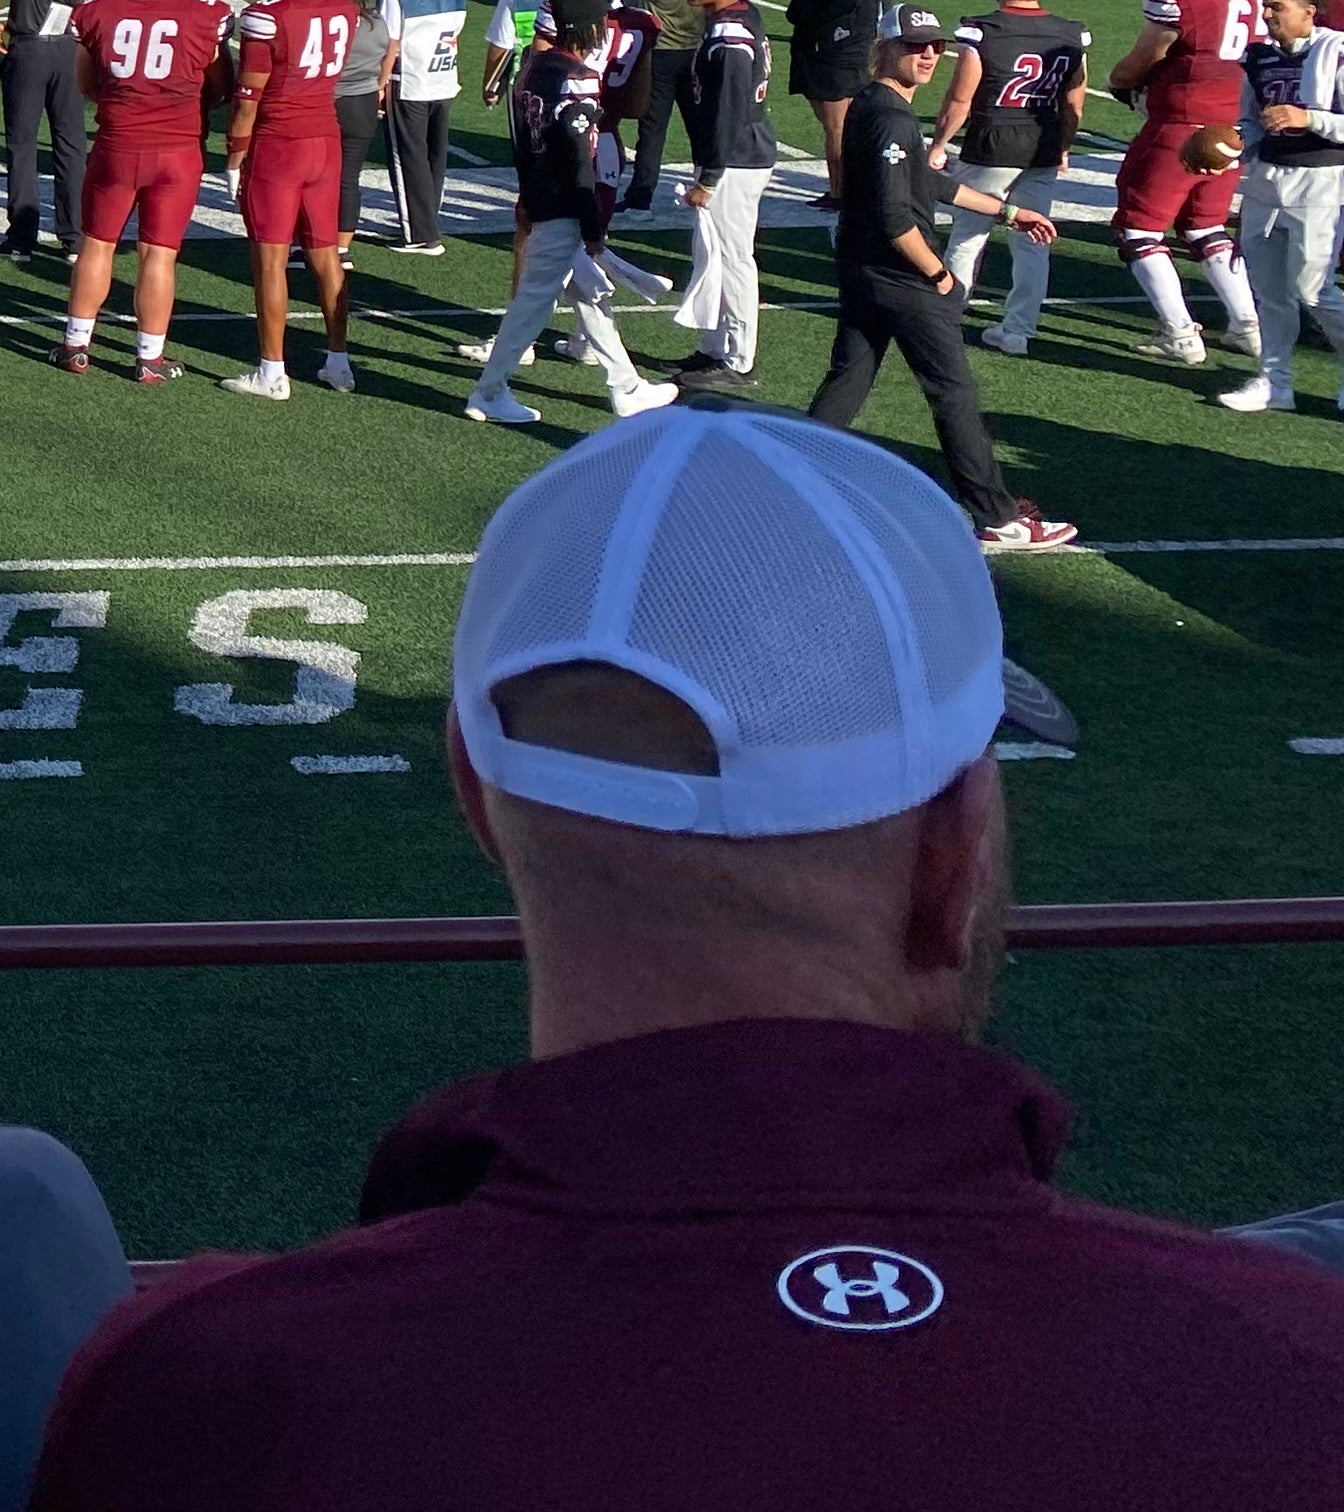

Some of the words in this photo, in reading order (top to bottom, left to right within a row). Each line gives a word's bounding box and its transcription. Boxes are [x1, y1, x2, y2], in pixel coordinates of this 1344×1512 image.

[110, 18, 179, 81] 96
[298, 13, 351, 80] 43
[995, 53, 1071, 109] 24
